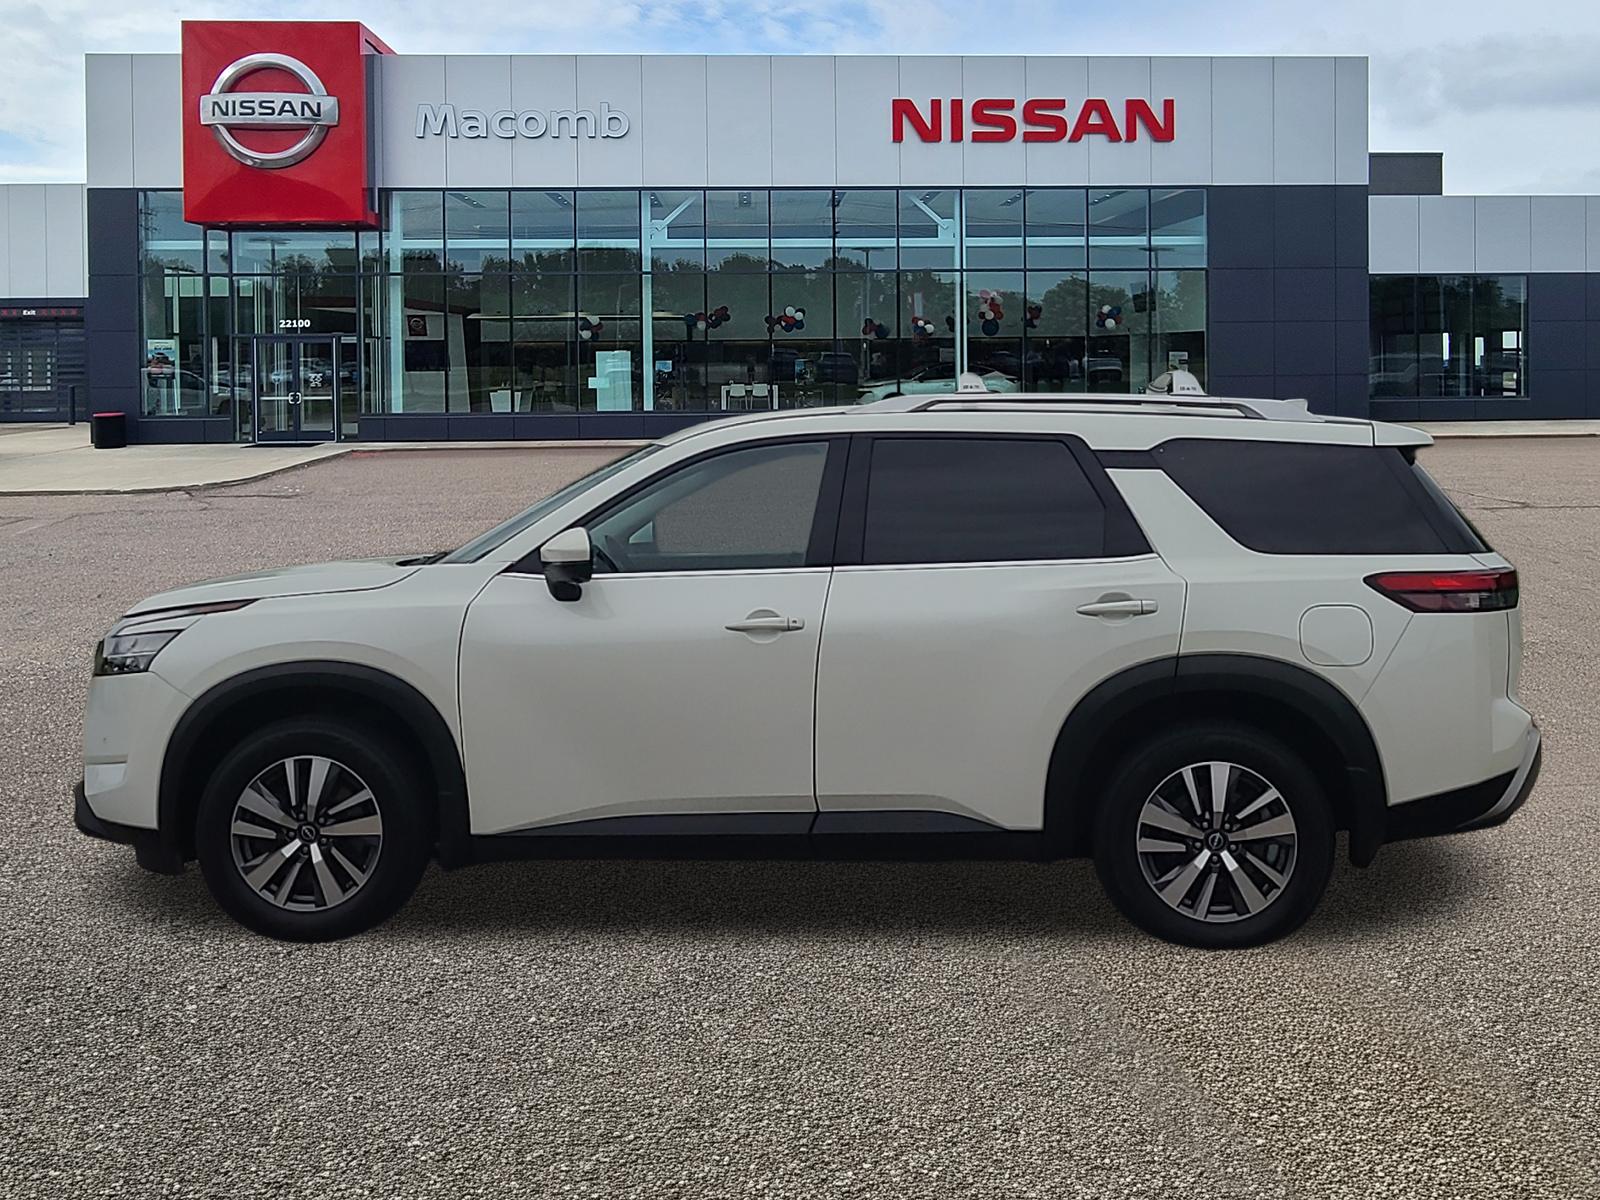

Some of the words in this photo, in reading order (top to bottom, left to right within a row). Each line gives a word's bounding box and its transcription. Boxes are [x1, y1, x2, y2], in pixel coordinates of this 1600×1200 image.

[211, 99, 322, 119] NISSAN
[415, 102, 631, 140] Macomb
[891, 98, 1176, 143] NISSAN
[279, 319, 311, 328] 22100
